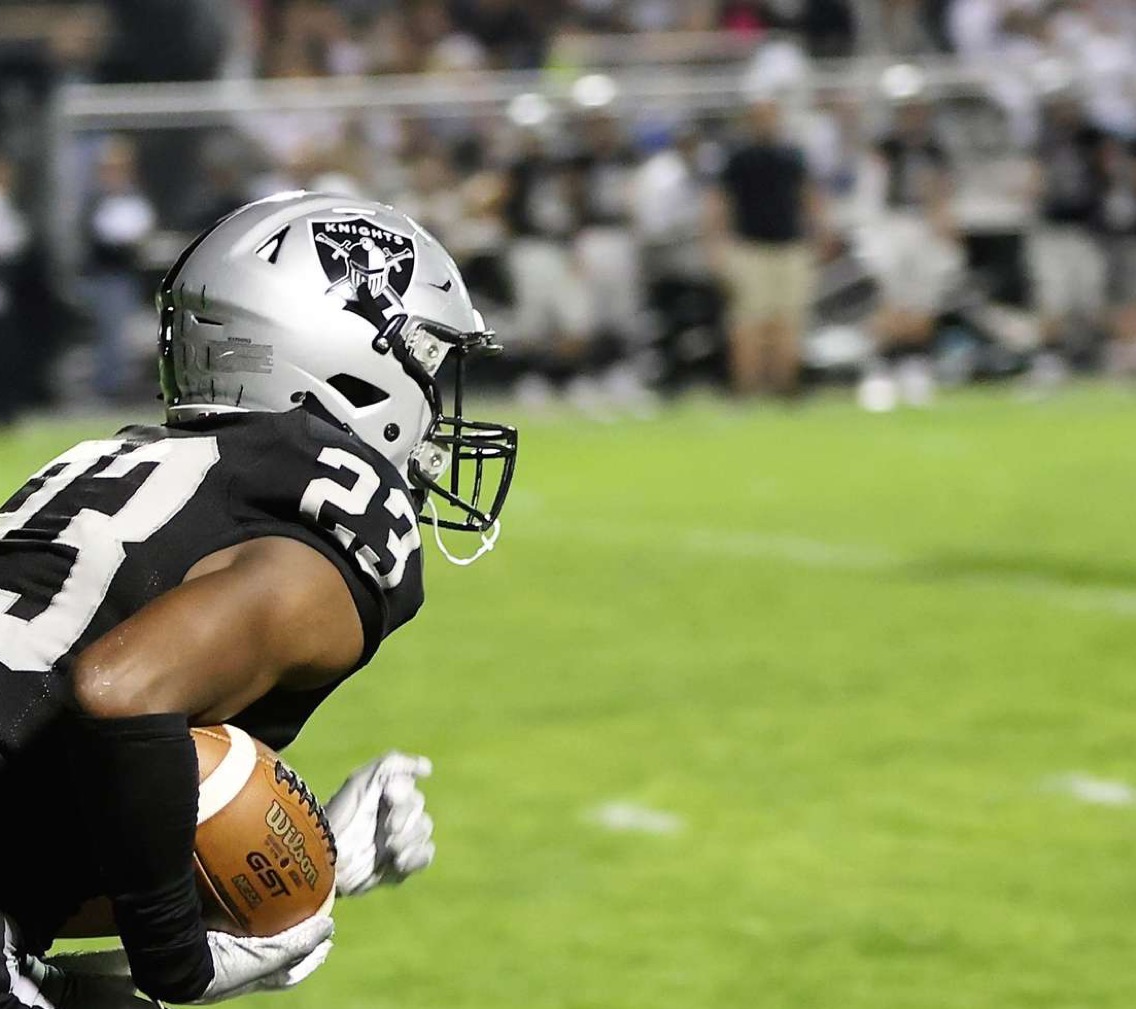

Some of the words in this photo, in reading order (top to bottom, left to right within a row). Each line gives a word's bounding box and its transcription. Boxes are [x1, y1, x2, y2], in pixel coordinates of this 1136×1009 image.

[324, 222, 404, 246] KNIGHTS
[298, 446, 421, 589] 23
[246, 851, 291, 897] GST
[265, 799, 319, 891] Wilson
